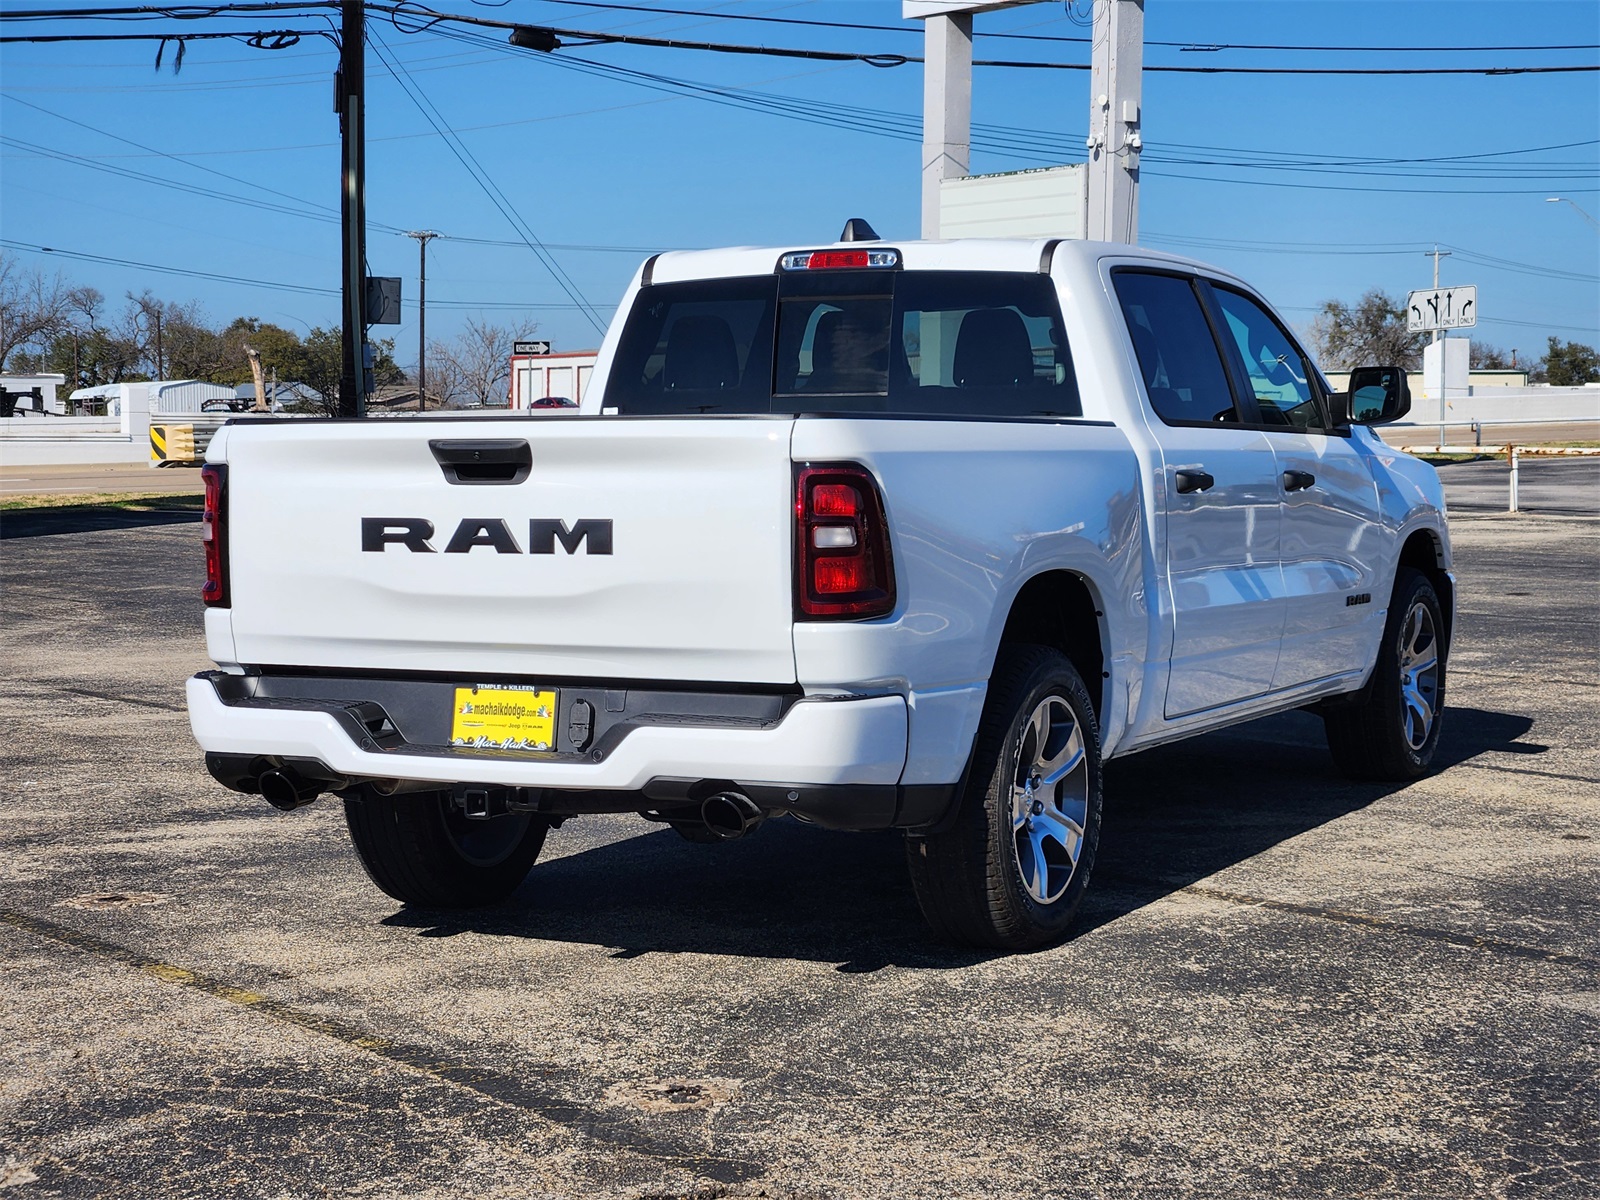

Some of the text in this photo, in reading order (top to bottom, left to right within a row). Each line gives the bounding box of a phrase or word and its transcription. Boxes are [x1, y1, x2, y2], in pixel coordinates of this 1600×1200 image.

[1460, 317, 1474, 325] ONLY
[361, 517, 614, 555] RAM
[1346, 593, 1371, 607] RAM
[473, 702, 536, 719] machaikdodge.com
[473, 735, 528, 749] Mac Haik
